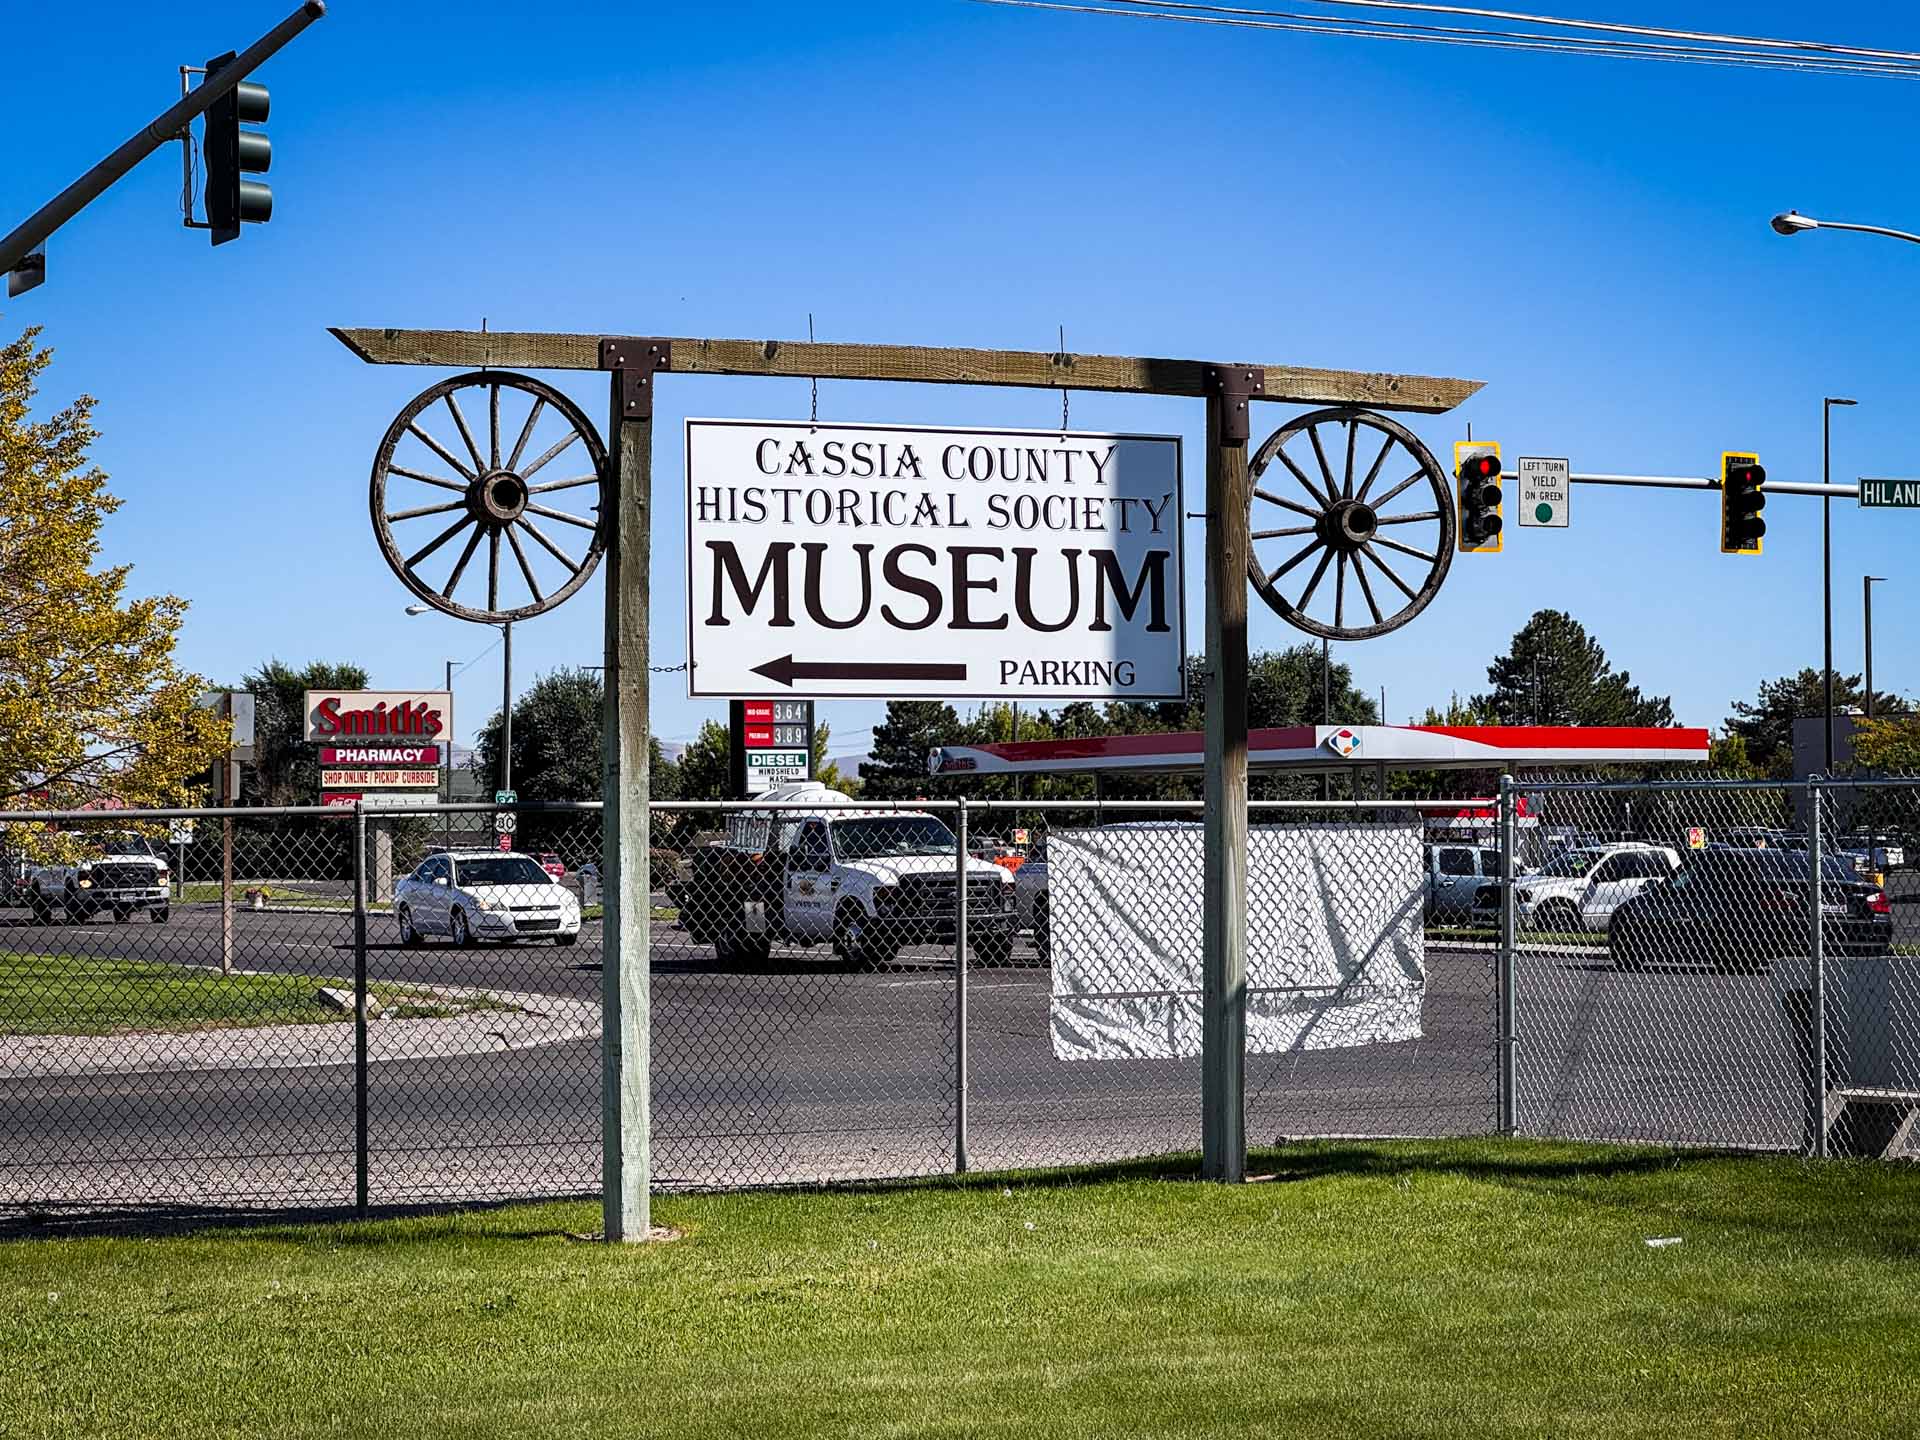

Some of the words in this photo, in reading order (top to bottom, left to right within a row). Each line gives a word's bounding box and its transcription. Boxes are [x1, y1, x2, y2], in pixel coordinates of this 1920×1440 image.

[755, 438, 922, 480] CASSIA
[942, 444, 1119, 484] COUNTY
[1523, 461, 1540, 471] LEFT
[1543, 462, 1564, 472] TURN
[1532, 475, 1557, 487] YIELD
[1525, 491, 1536, 501] ON
[1539, 491, 1564, 501] GREEN
[1864, 482, 1920, 504] HILAN
[696, 486, 970, 529] HISTORICAL
[986, 491, 1174, 533] SOCIETY
[704, 540, 1171, 633] MUSEUM
[999, 660, 1136, 687] PARKING
[318, 698, 443, 736] Smith's
[335, 748, 424, 762] PHARMACY
[751, 754, 804, 766] DIESEL
[324, 772, 342, 784] SHOP
[343, 772, 368, 784] ONLINE
[374, 771, 399, 784] PICKUP
[401, 771, 436, 784] CURBSIDE
